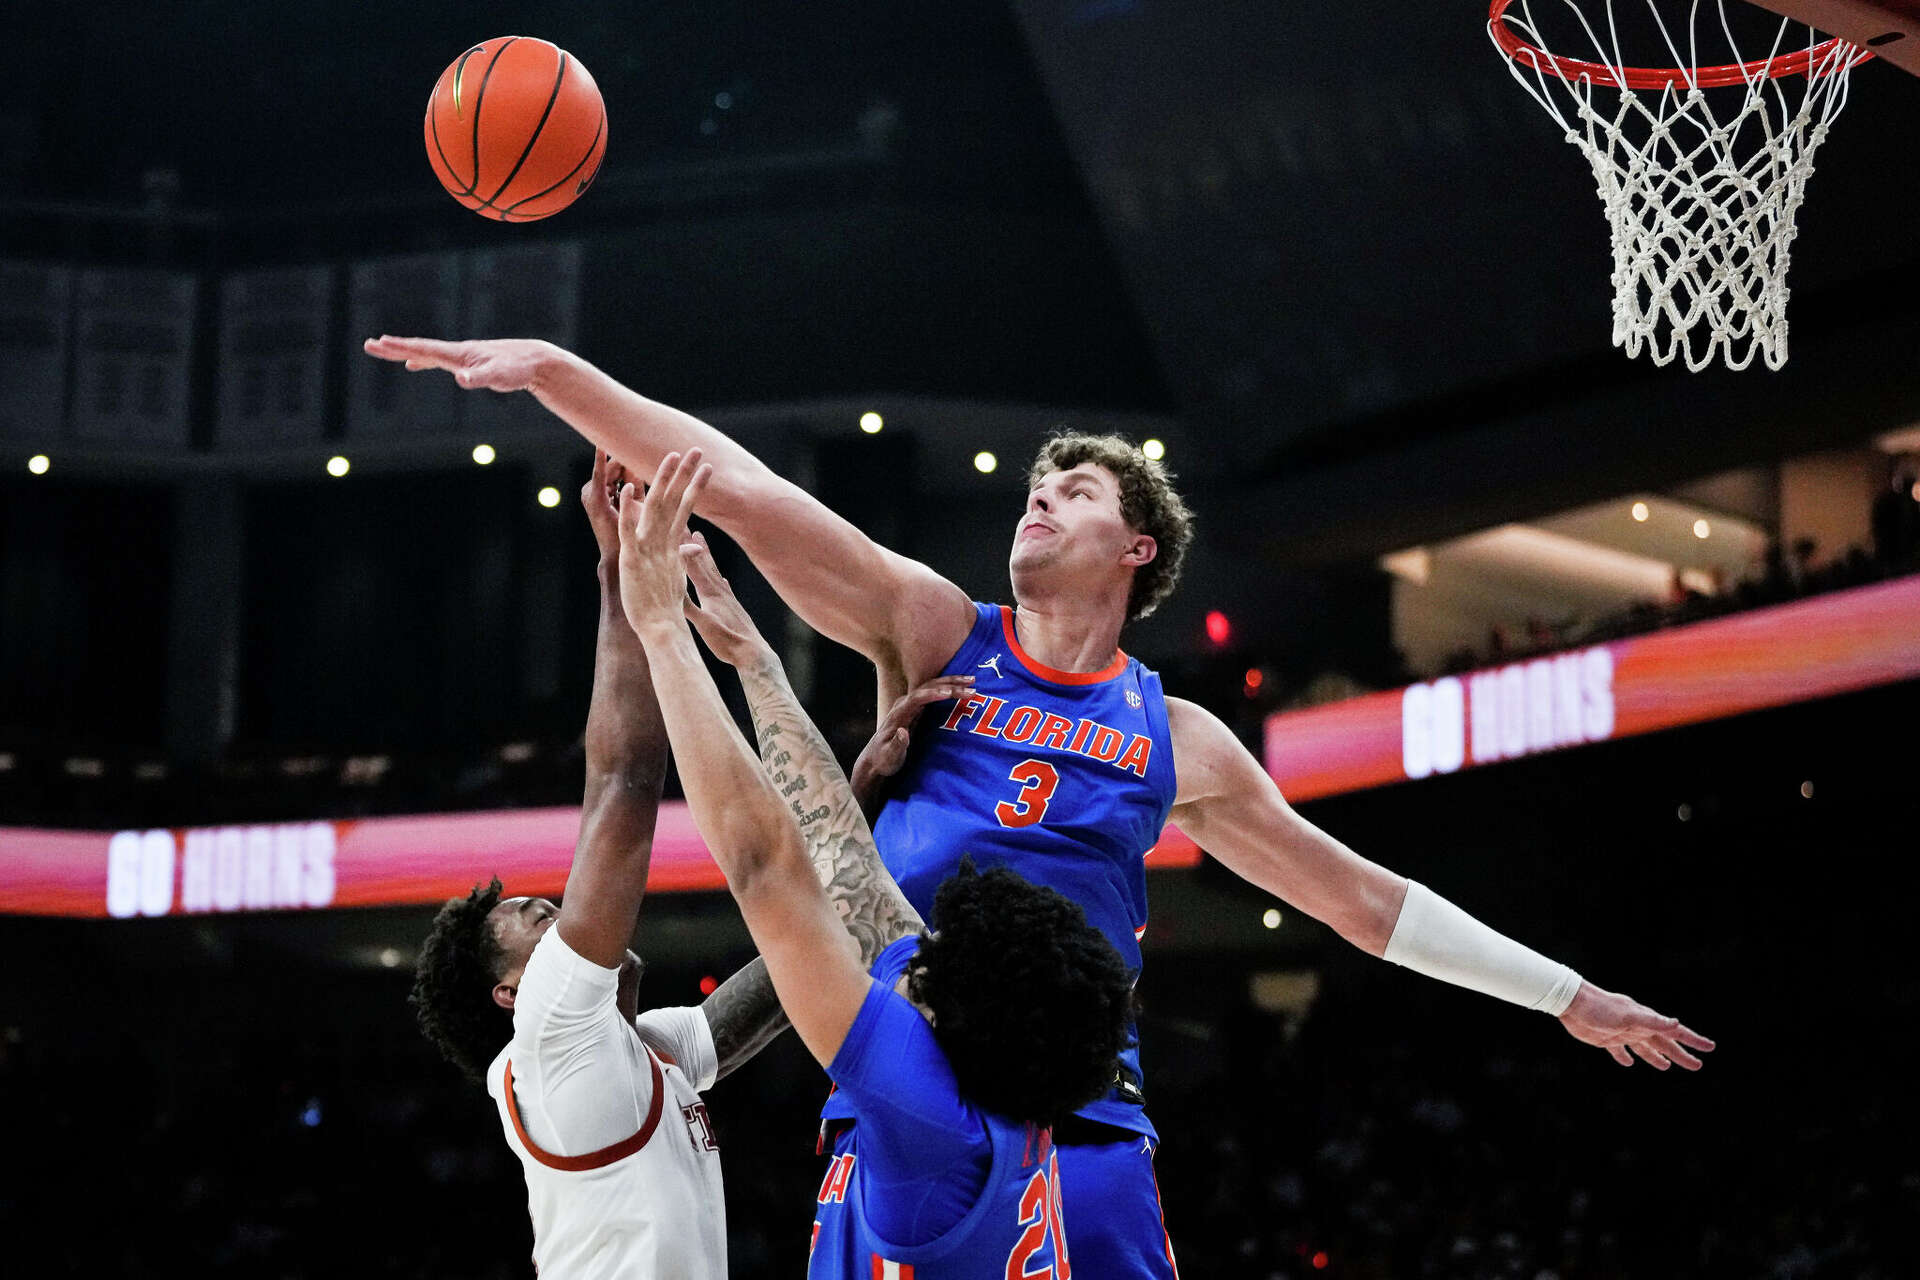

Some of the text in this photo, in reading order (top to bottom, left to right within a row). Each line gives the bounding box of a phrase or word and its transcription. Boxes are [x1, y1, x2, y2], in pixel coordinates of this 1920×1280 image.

[1125, 690, 1141, 708] SEC
[940, 692, 1152, 778] FLORIDA
[994, 758, 1060, 829] 3
